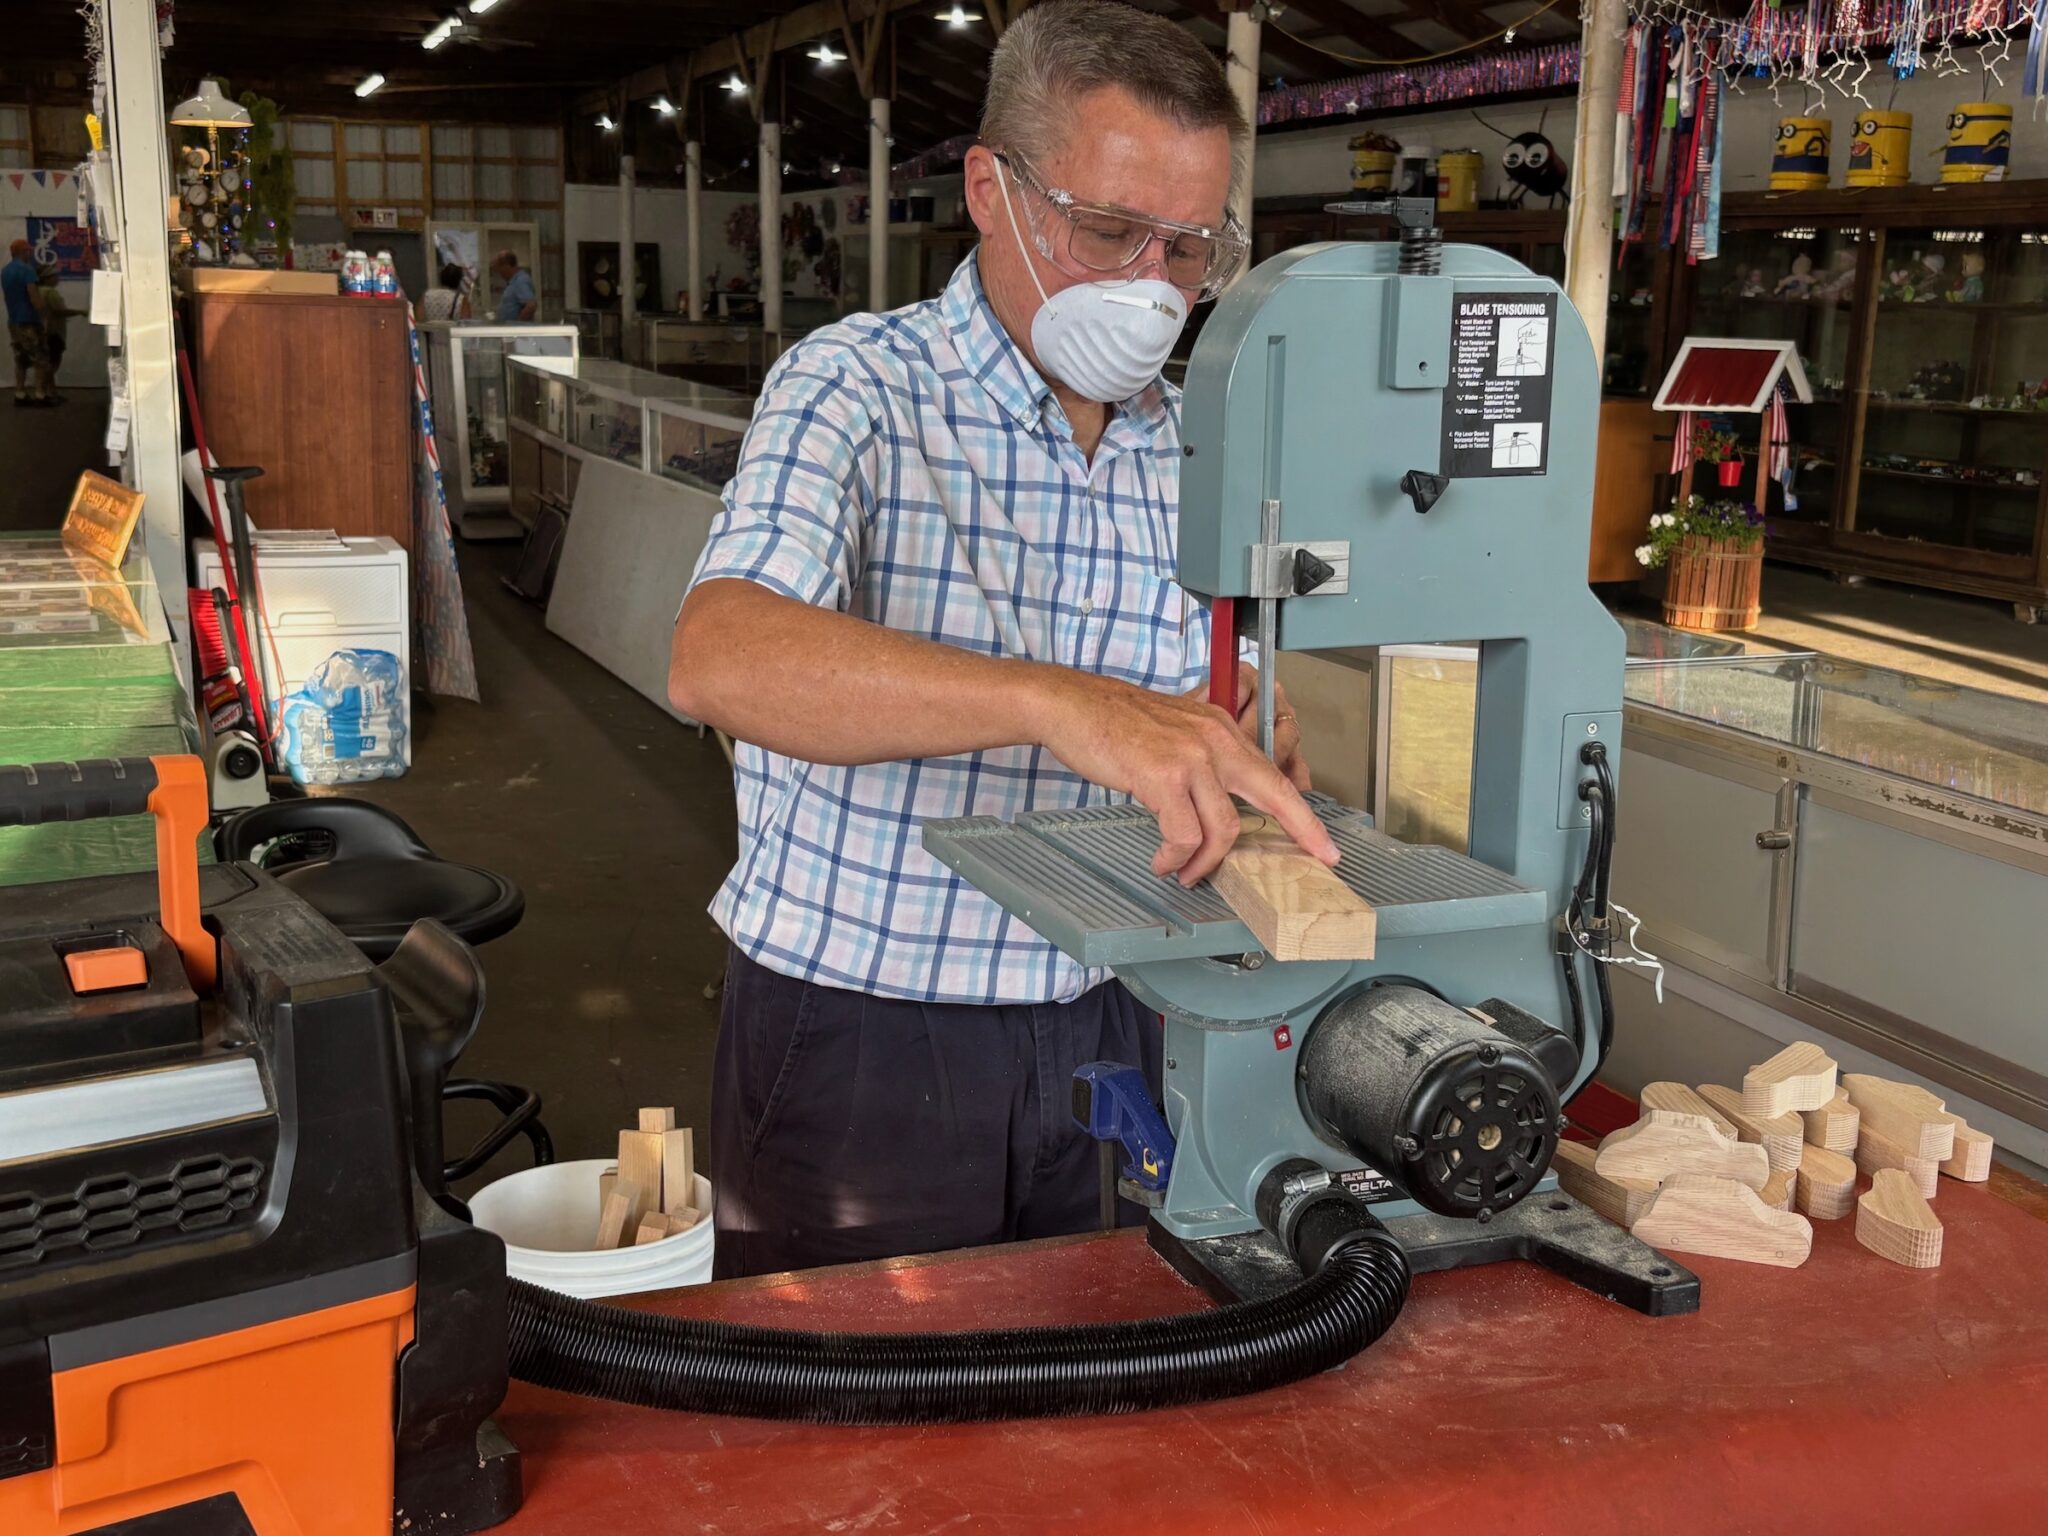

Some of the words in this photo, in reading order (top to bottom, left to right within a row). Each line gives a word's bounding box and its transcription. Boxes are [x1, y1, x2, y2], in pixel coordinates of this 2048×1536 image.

[1460, 303, 1490, 316] BLADE
[1491, 303, 1546, 316] TENSIONING
[1349, 1179, 1394, 1193] DELTA
